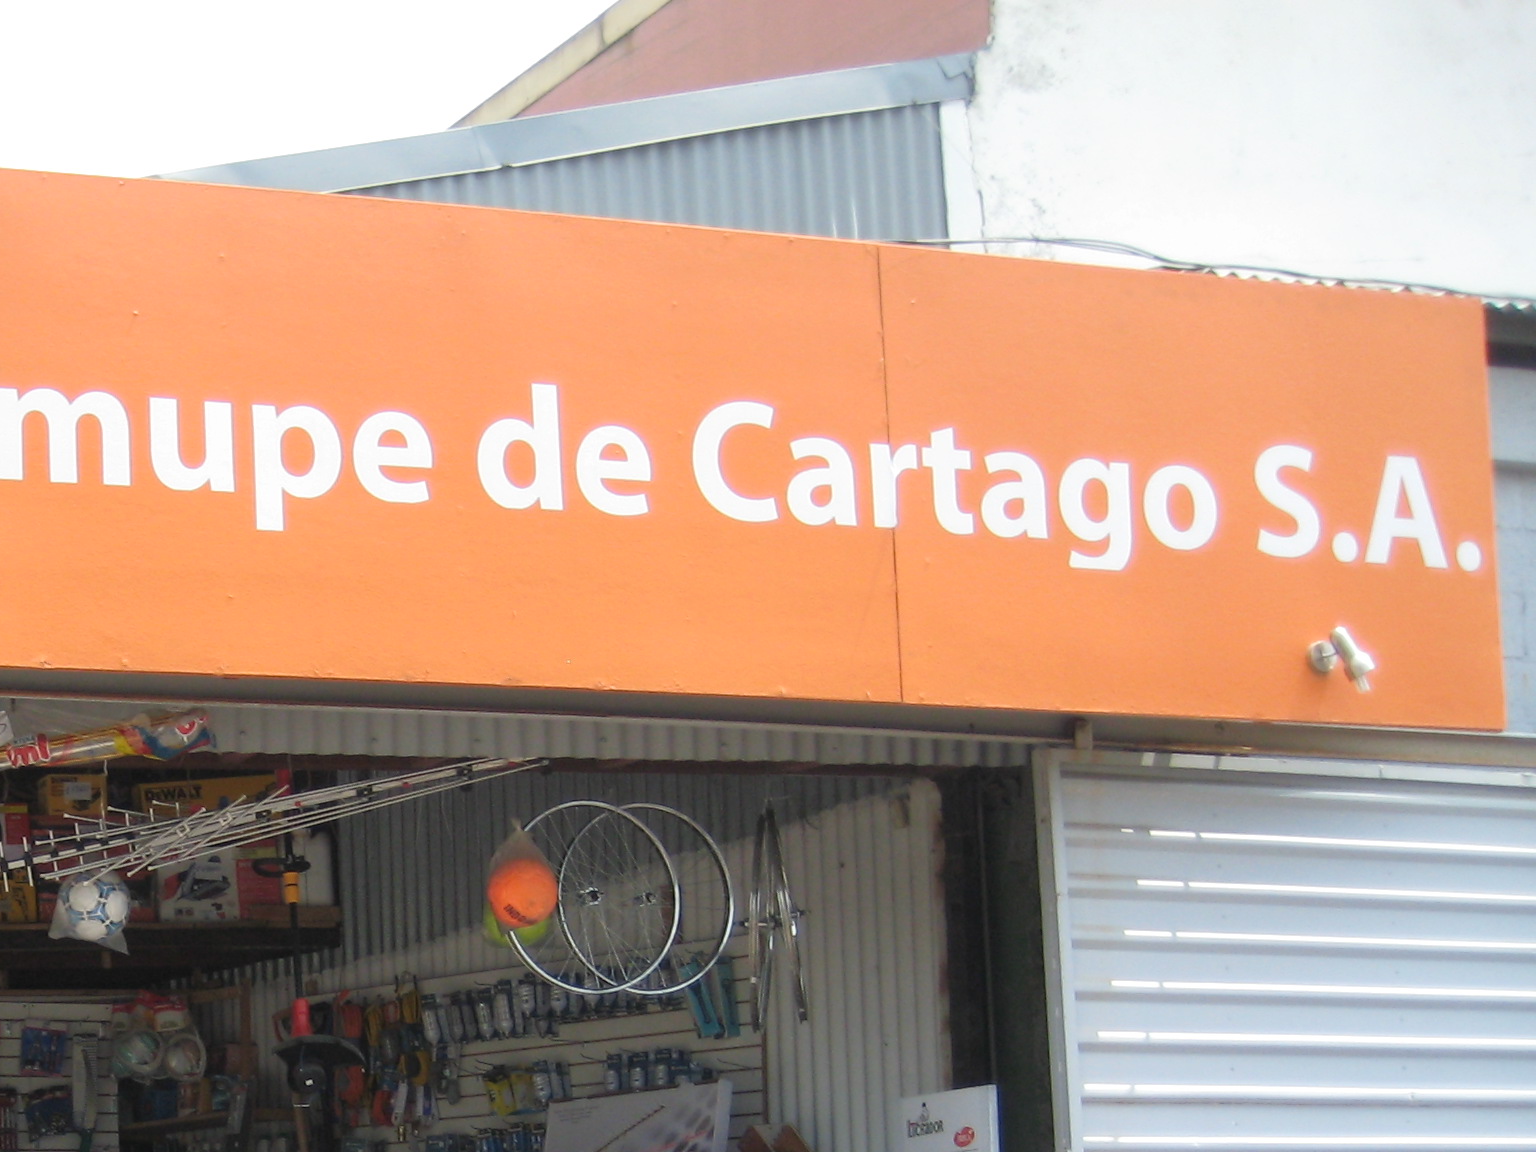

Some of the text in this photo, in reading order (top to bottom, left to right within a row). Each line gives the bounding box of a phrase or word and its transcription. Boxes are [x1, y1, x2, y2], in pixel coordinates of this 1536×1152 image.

[477, 382, 651, 516] de
[692, 401, 1218, 570] Cartago
[1254, 444, 1482, 572] S.A.
